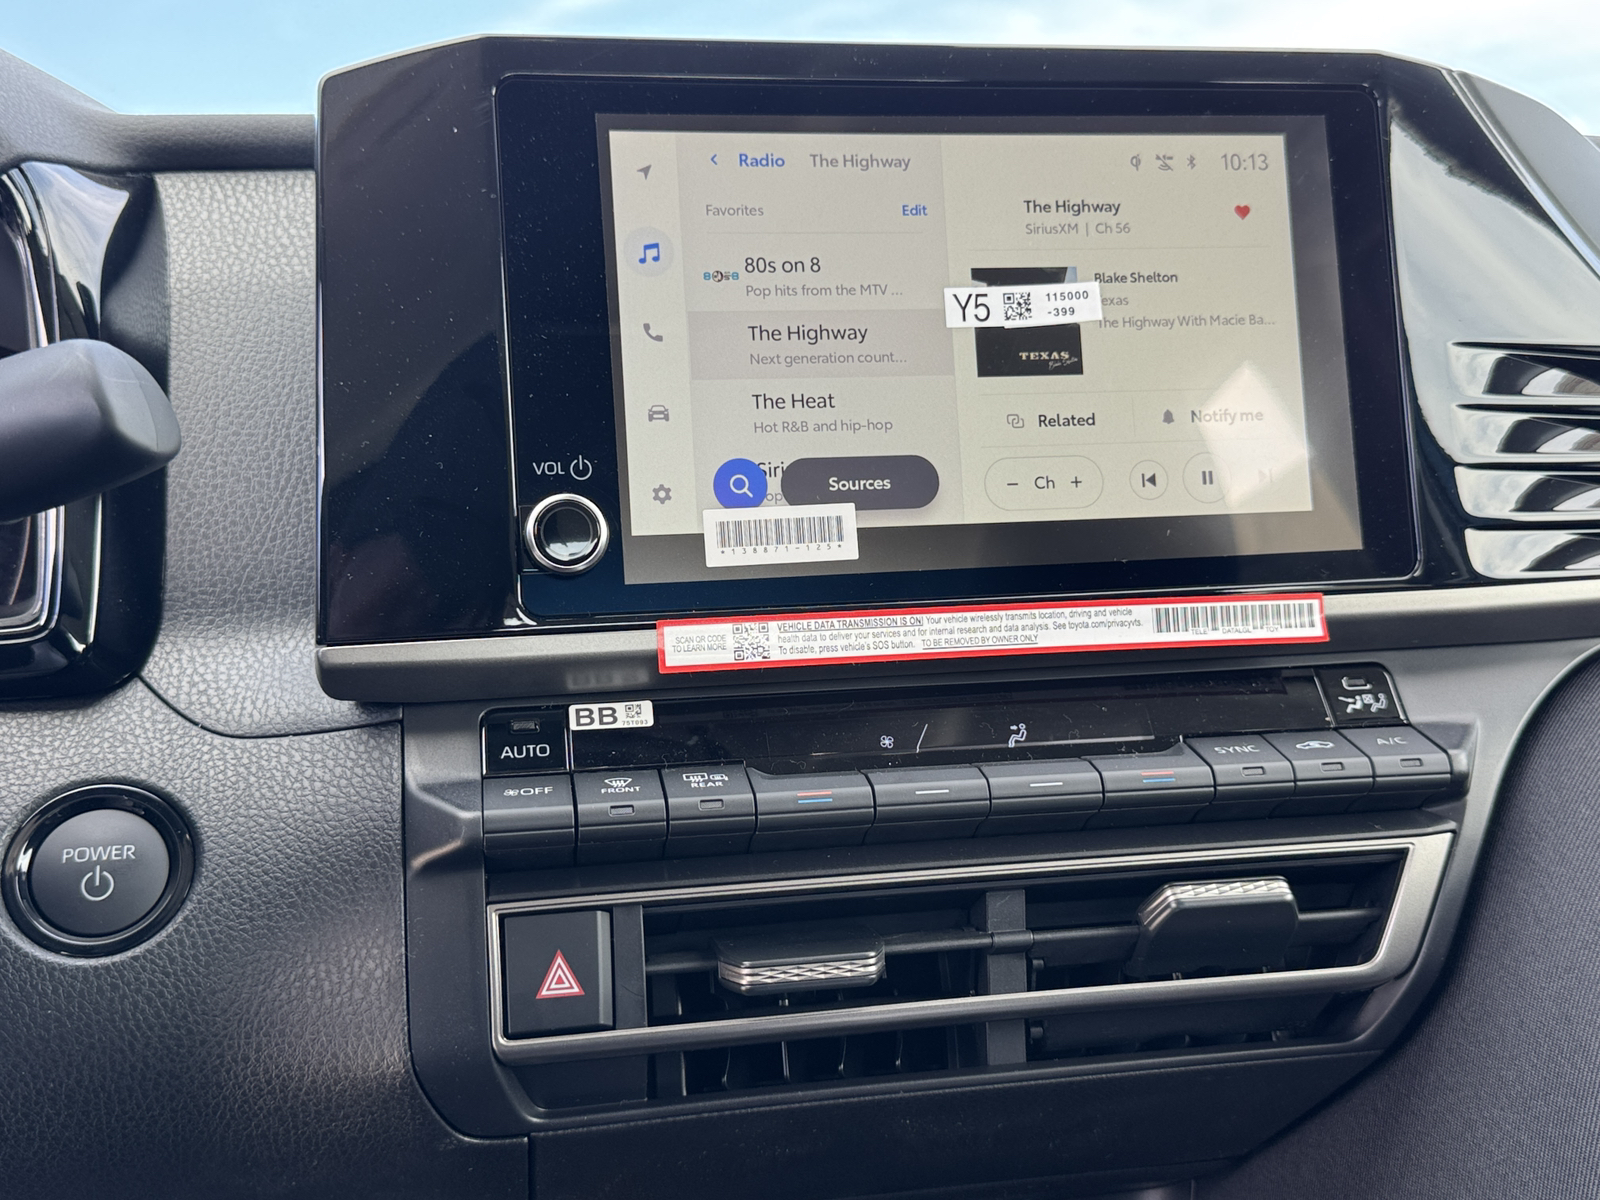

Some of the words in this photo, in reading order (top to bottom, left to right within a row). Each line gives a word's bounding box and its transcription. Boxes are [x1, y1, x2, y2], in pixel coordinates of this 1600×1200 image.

[739, 153, 785, 168] Radio
[810, 154, 839, 168] The
[843, 153, 911, 171] Highway
[1220, 153, 1269, 171] 10:13
[705, 204, 764, 217] Favorites
[901, 204, 928, 217] Edit
[1023, 200, 1051, 213] The
[1055, 199, 1121, 216] Highway
[1025, 223, 1079, 235] SiriusXM
[1095, 222, 1113, 234] Ch
[1115, 222, 1131, 234] 56
[744, 257, 776, 273] 80s
[781, 260, 805, 273] on
[810, 256, 821, 273] 8
[1094, 272, 1128, 284] Blake
[1129, 271, 1178, 283] Shelton
[745, 286, 771, 299] Pop
[774, 284, 798, 296] hits
[801, 284, 832, 296] from
[835, 284, 856, 296] the
[860, 284, 888, 296] MTV
[1045, 290, 1089, 302] 115000
[952, 293, 991, 322] Y5
[1100, 295, 1129, 306] exas
[1047, 307, 1075, 317] -399
[1122, 315, 1175, 331] Highway
[1178, 314, 1206, 327] With
[1209, 314, 1245, 326] Macie
[748, 326, 782, 341] The
[787, 325, 868, 345] Highway
[749, 353, 781, 365] Next
[784, 352, 854, 368] generation
[1019, 351, 1070, 360] TEXAS
[752, 394, 786, 409] The
[791, 393, 835, 409] Heat
[1038, 413, 1096, 427] Related
[1190, 408, 1238, 426] Notify
[1240, 411, 1264, 421] me
[753, 421, 778, 433] Hot
[782, 421, 809, 433] R&B
[812, 420, 838, 432] and
[841, 419, 893, 434] hip-hop
[532, 461, 566, 475] VOL
[828, 476, 891, 491] Sources
[1034, 475, 1056, 490] Ch
[777, 621, 812, 632] VEHICLE
[814, 620, 835, 630] DATA
[837, 618, 898, 629] TRANSMISSION
[900, 617, 908, 626] IS
[926, 616, 942, 625] Your
[944, 614, 968, 624] vehicle
[970, 612, 1004, 624] wirelessly
[1005, 611, 1037, 621] transmits
[1038, 610, 1067, 620] location,
[1069, 608, 1091, 620] driving
[1094, 608, 1107, 617] and
[1108, 607, 1132, 616] vehicle
[675, 636, 694, 645] SCAN
[706, 634, 726, 643] CODE
[777, 634, 800, 644] health
[802, 633, 817, 642] data
[819, 633, 827, 642] to
[828, 631, 853, 641] deliver
[854, 631, 870, 642] your
[871, 629, 901, 639] services
[902, 628, 916, 637] and
[917, 627, 927, 636] for
[929, 625, 955, 636] internal
[957, 624, 987, 635] research
[989, 624, 1002, 633] and
[1003, 623, 1019, 632] data
[1020, 621, 1051, 633] analysis.
[1052, 620, 1067, 630] See
[672, 645, 682, 653] TO
[683, 643, 706, 652] LEARN
[706, 642, 727, 651] MORE
[778, 645, 787, 655] To
[788, 643, 817, 655] disable,
[818, 643, 839, 655] press
[841, 641, 871, 652] vehicle's
[872, 640, 889, 650] SOS
[891, 639, 916, 650] button.
[921, 639, 931, 648] TO
[933, 638, 943, 647] BE
[944, 635, 980, 646] REMOVED
[981, 635, 990, 644] BY
[991, 634, 1019, 644] OWNER
[1019, 633, 1038, 643] ONLY
[575, 706, 619, 727] BB
[1376, 735, 1408, 746] A/C
[501, 744, 550, 759] AUTO
[1214, 743, 1261, 755] SYNC
[520, 786, 554, 797] OFF
[601, 785, 641, 795] FRONT
[691, 780, 724, 789] REAR
[62, 845, 136, 863] POWER
